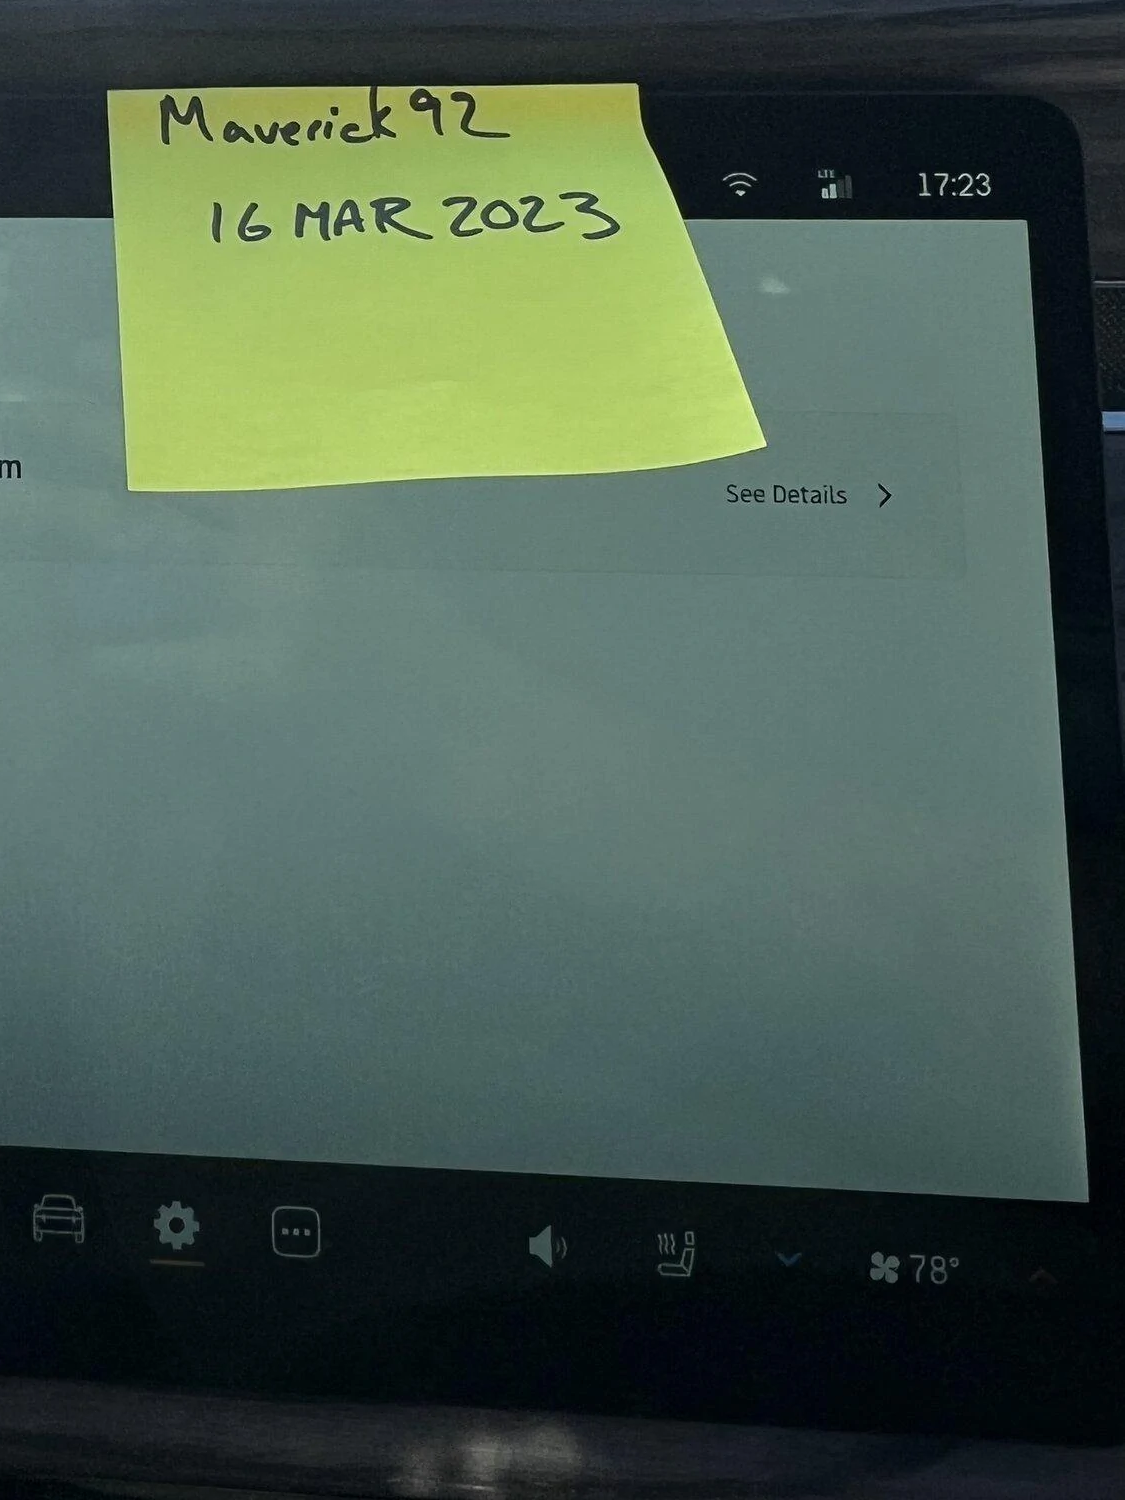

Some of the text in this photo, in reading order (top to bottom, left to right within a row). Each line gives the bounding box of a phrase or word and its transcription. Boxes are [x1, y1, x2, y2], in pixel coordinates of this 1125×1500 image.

[918, 172, 992, 197] 17:23
[212, 191, 622, 244] 16 MAR 2023
[726, 483, 848, 505] See Details
